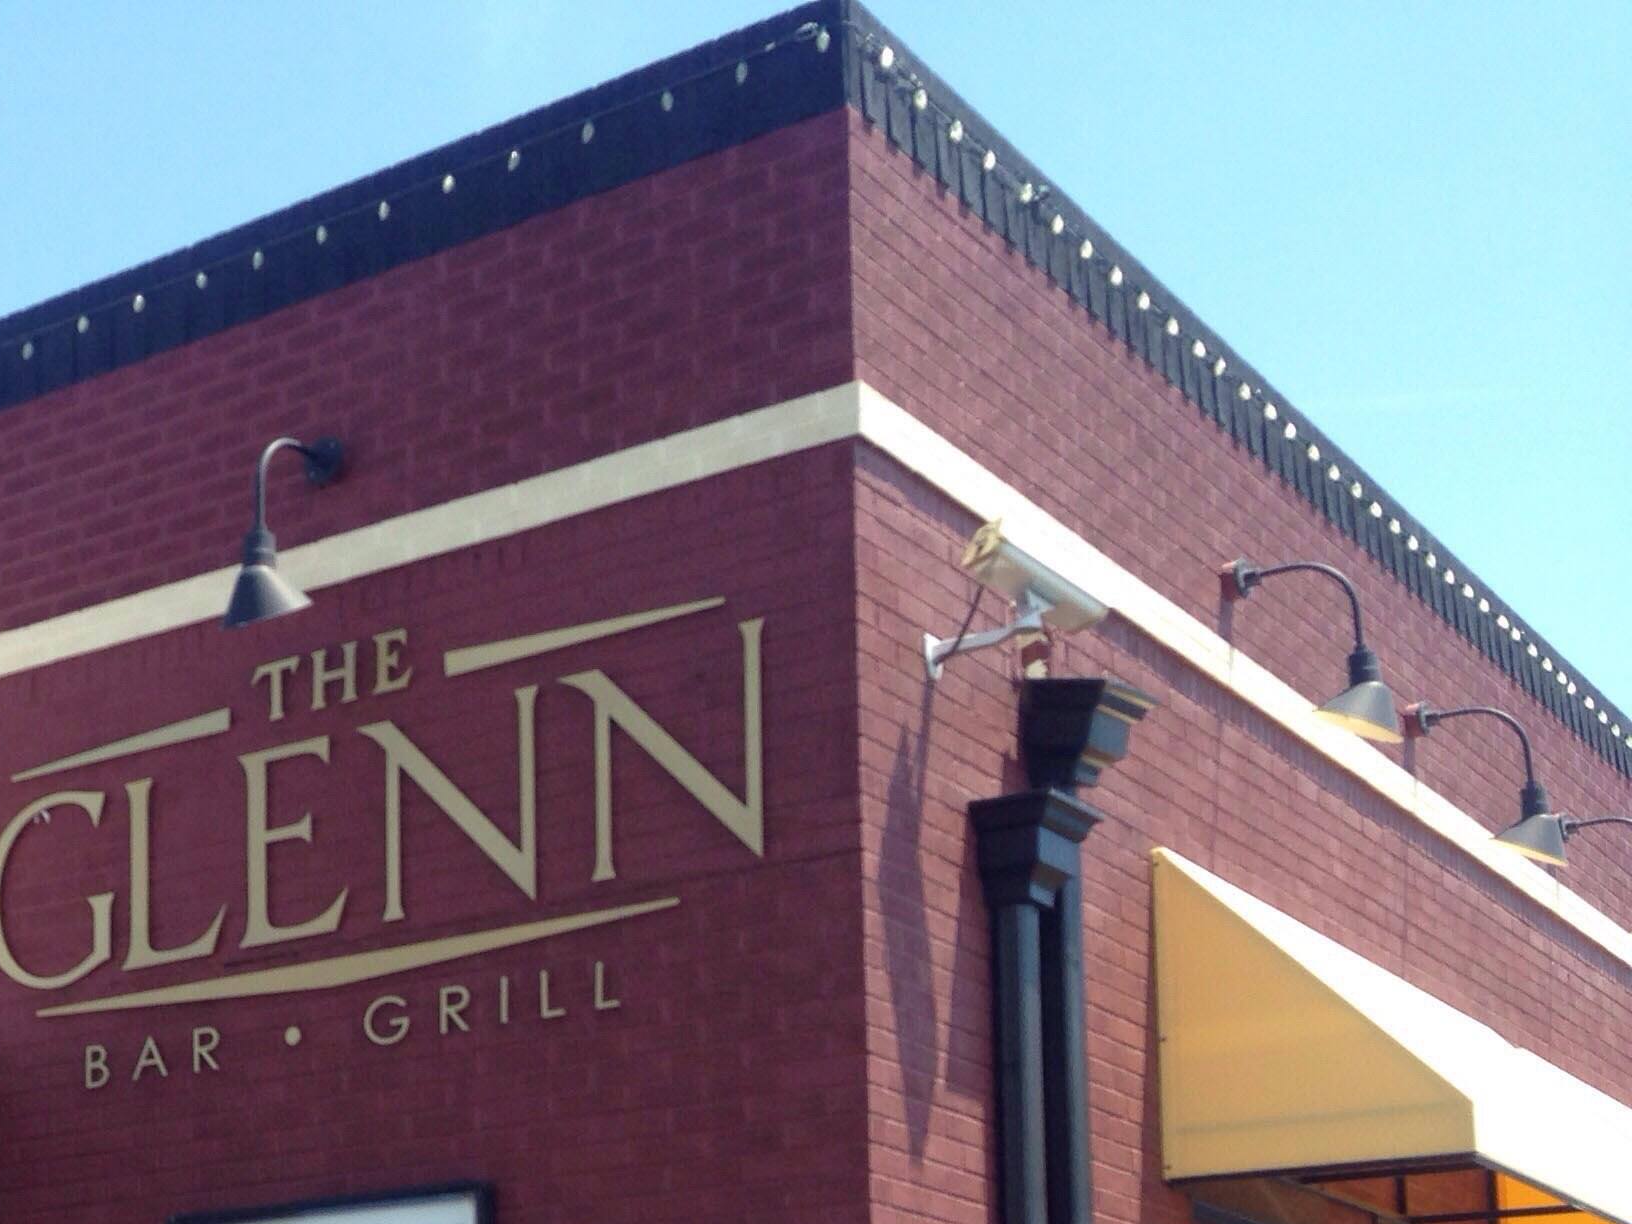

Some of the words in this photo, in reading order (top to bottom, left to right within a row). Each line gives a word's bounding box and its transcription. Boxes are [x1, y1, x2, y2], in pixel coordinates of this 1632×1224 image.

[250, 627, 414, 723] THE
[83, 1025, 221, 1090] BAR
[362, 960, 622, 1047] GRILL
